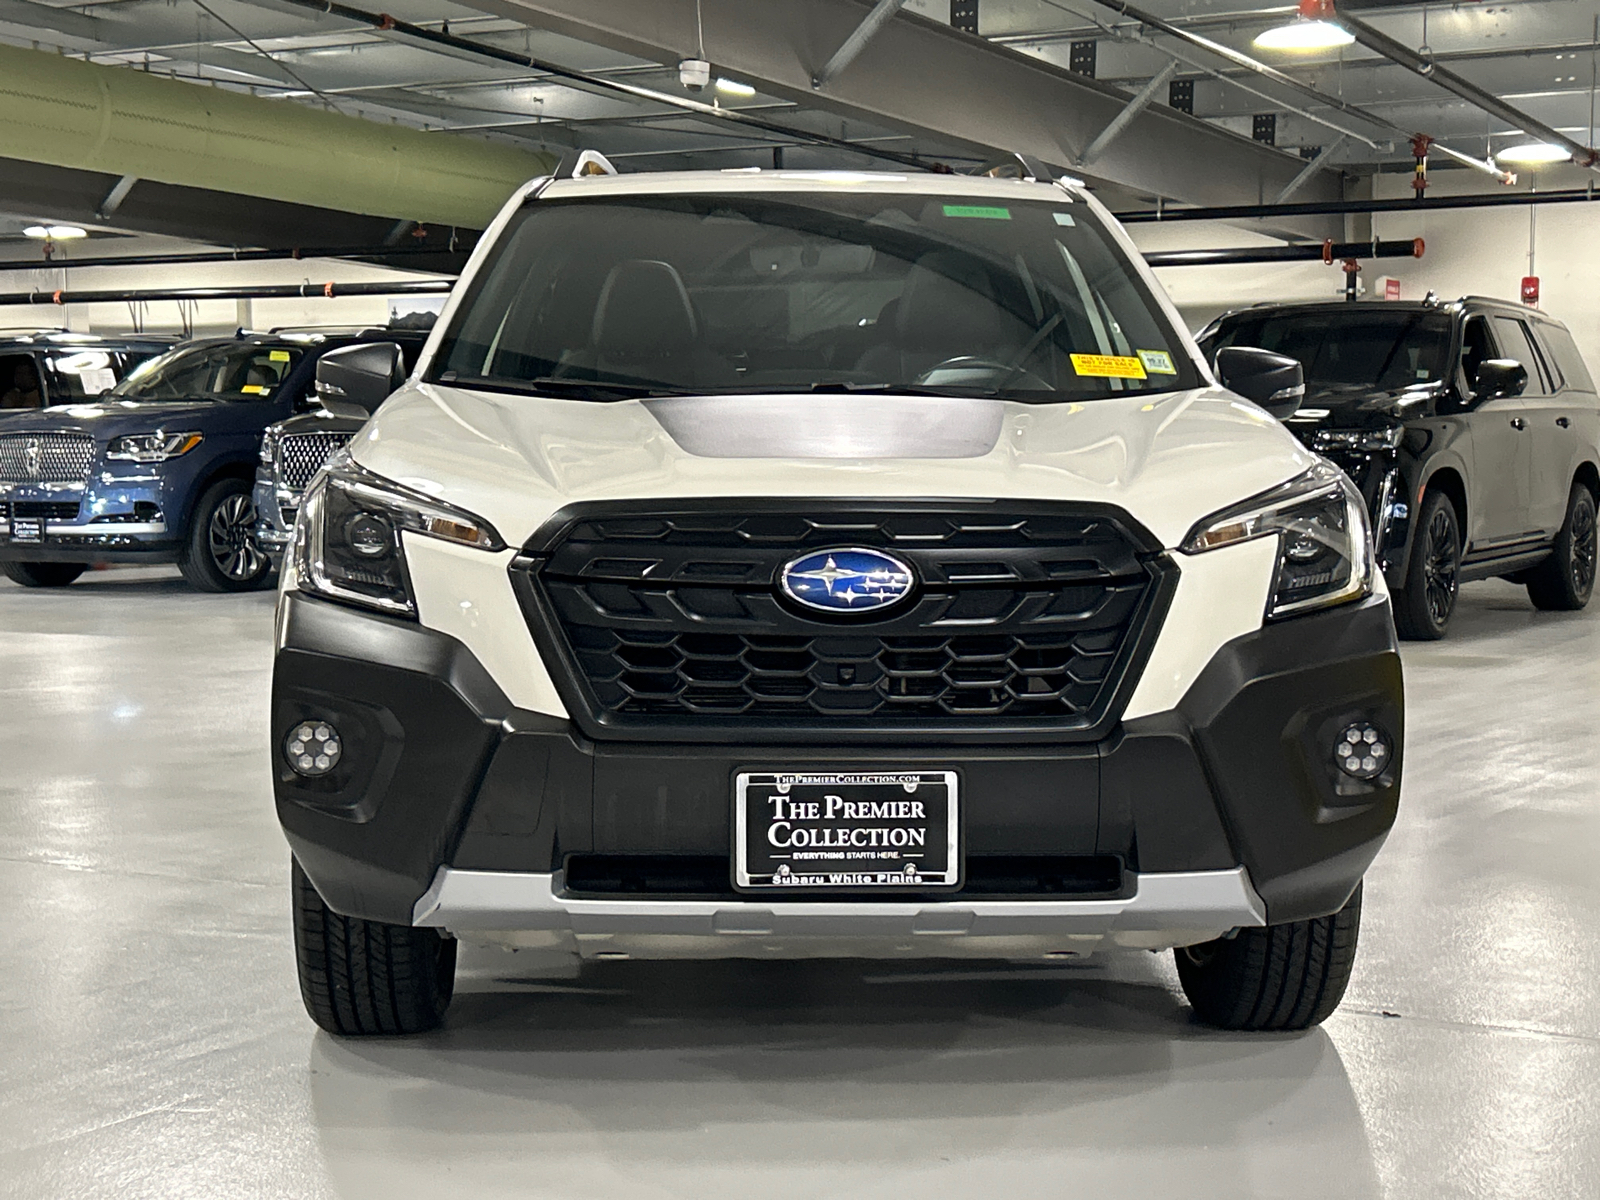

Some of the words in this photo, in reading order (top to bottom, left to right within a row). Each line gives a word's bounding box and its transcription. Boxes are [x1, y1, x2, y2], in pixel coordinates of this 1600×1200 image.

[768, 795, 820, 820] THE
[824, 795, 926, 819] PREMIER
[768, 822, 925, 847] COLLECTION
[793, 852, 845, 860] EVERYTHING
[846, 851, 876, 860] STARTS
[772, 874, 825, 885] Subaru
[830, 874, 872, 884] White
[877, 873, 923, 884] Plains
